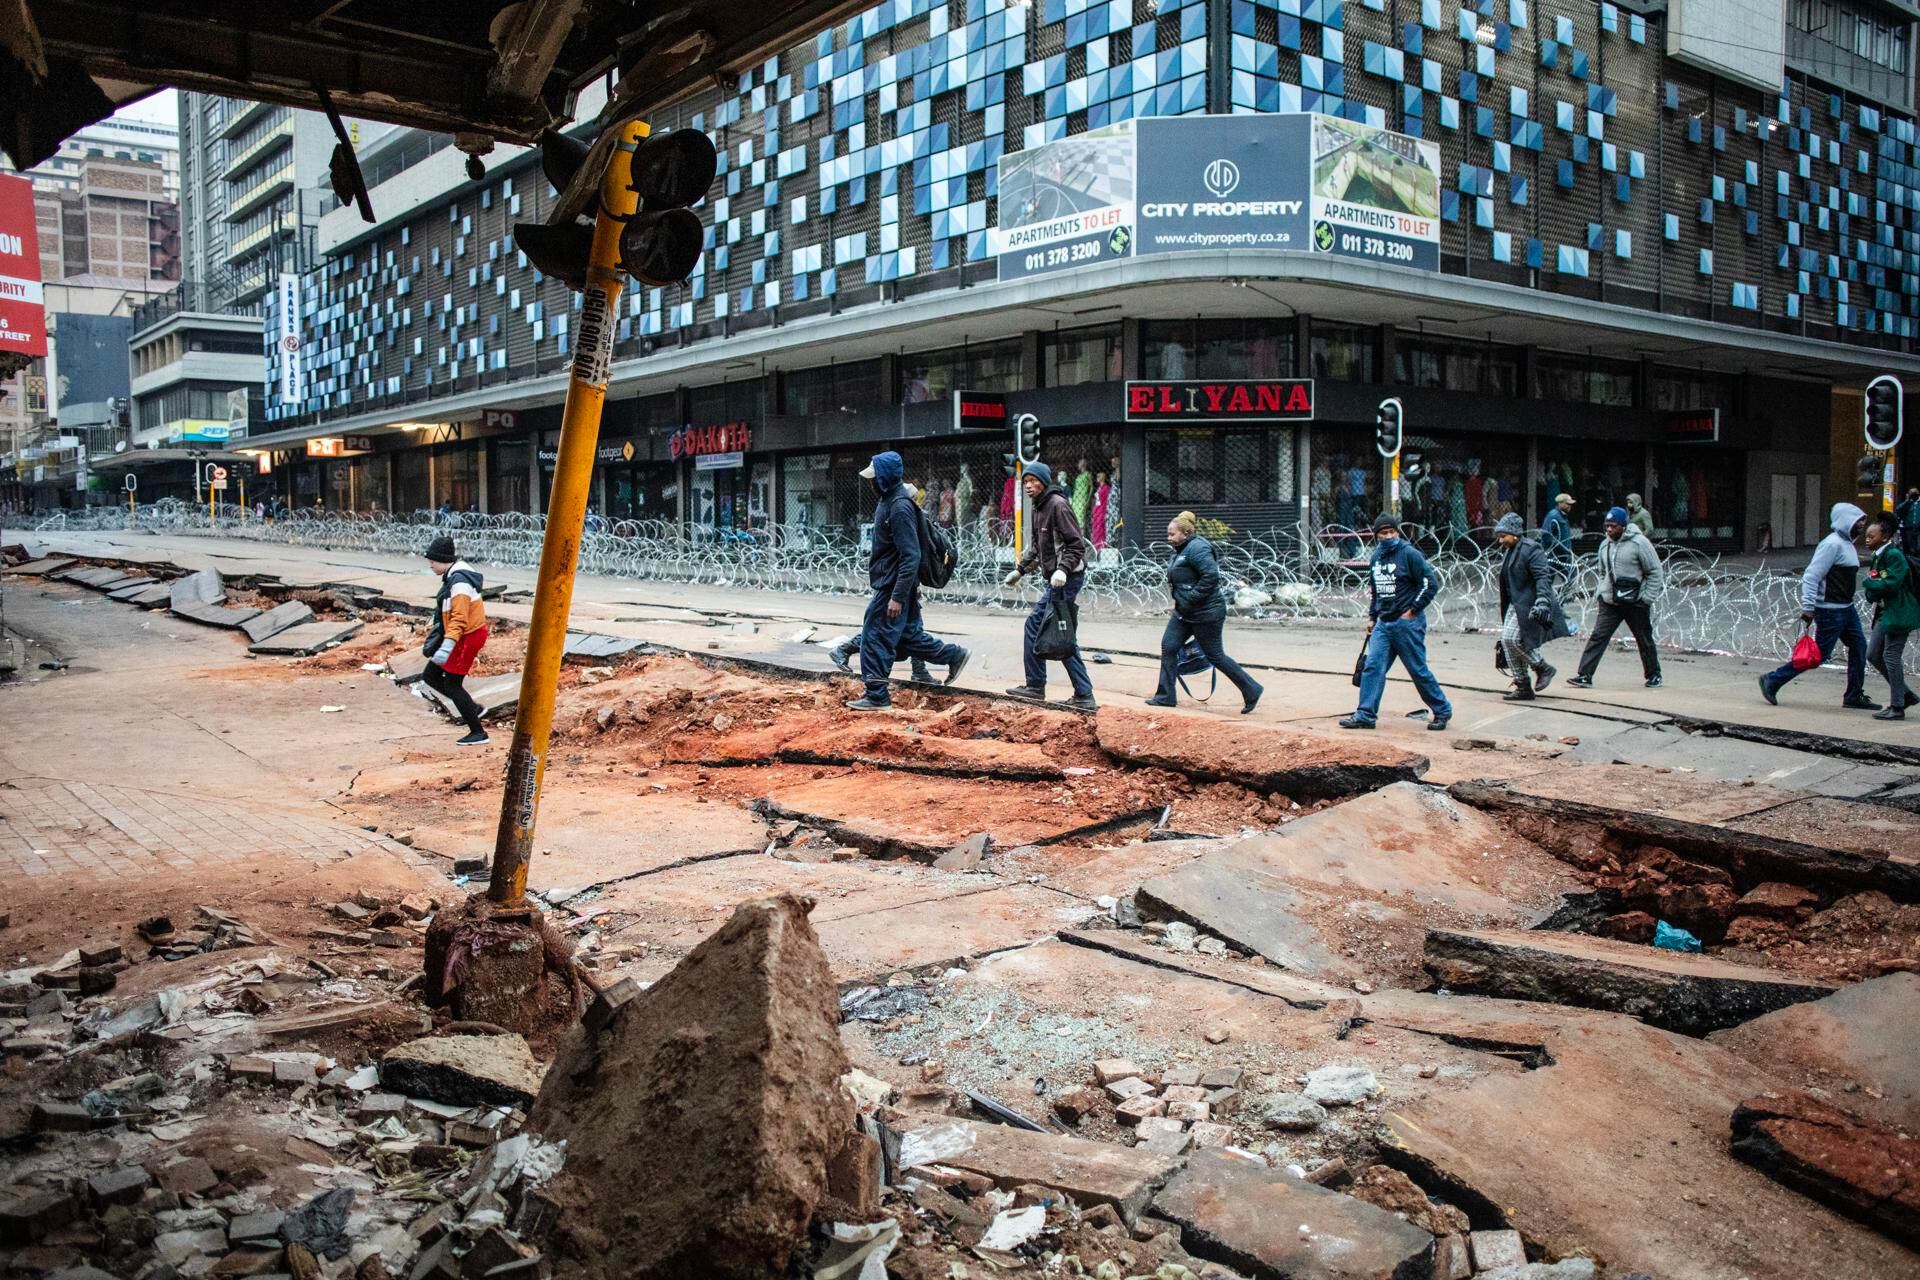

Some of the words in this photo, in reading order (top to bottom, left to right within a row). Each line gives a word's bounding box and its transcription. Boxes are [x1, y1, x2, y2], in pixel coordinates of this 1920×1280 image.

[1141, 203, 1189, 217] CITY
[1193, 200, 1303, 216] PROPERTY
[1324, 203, 1395, 230] APARTMENTS
[1397, 217, 1411, 233] TO
[1414, 222, 1430, 236] LET
[1008, 218, 1080, 247] APARTMENTS
[1083, 214, 1098, 230] TO
[1101, 208, 1122, 226] LET
[1155, 232, 1290, 245] www.cityproperty.co.za
[0, 233, 23, 256] ON
[1025, 252, 1045, 270] 011
[1047, 247, 1069, 266] 378
[1070, 240, 1101, 261] 3200
[1342, 233, 1361, 252] 011
[1364, 237, 1385, 256] 378
[1387, 242, 1414, 261] 3200
[0, 318, 9, 329] 6
[1129, 384, 1311, 412] ELIYANA
[487, 411, 515, 428] PQ
[686, 422, 751, 456] DAKOTA
